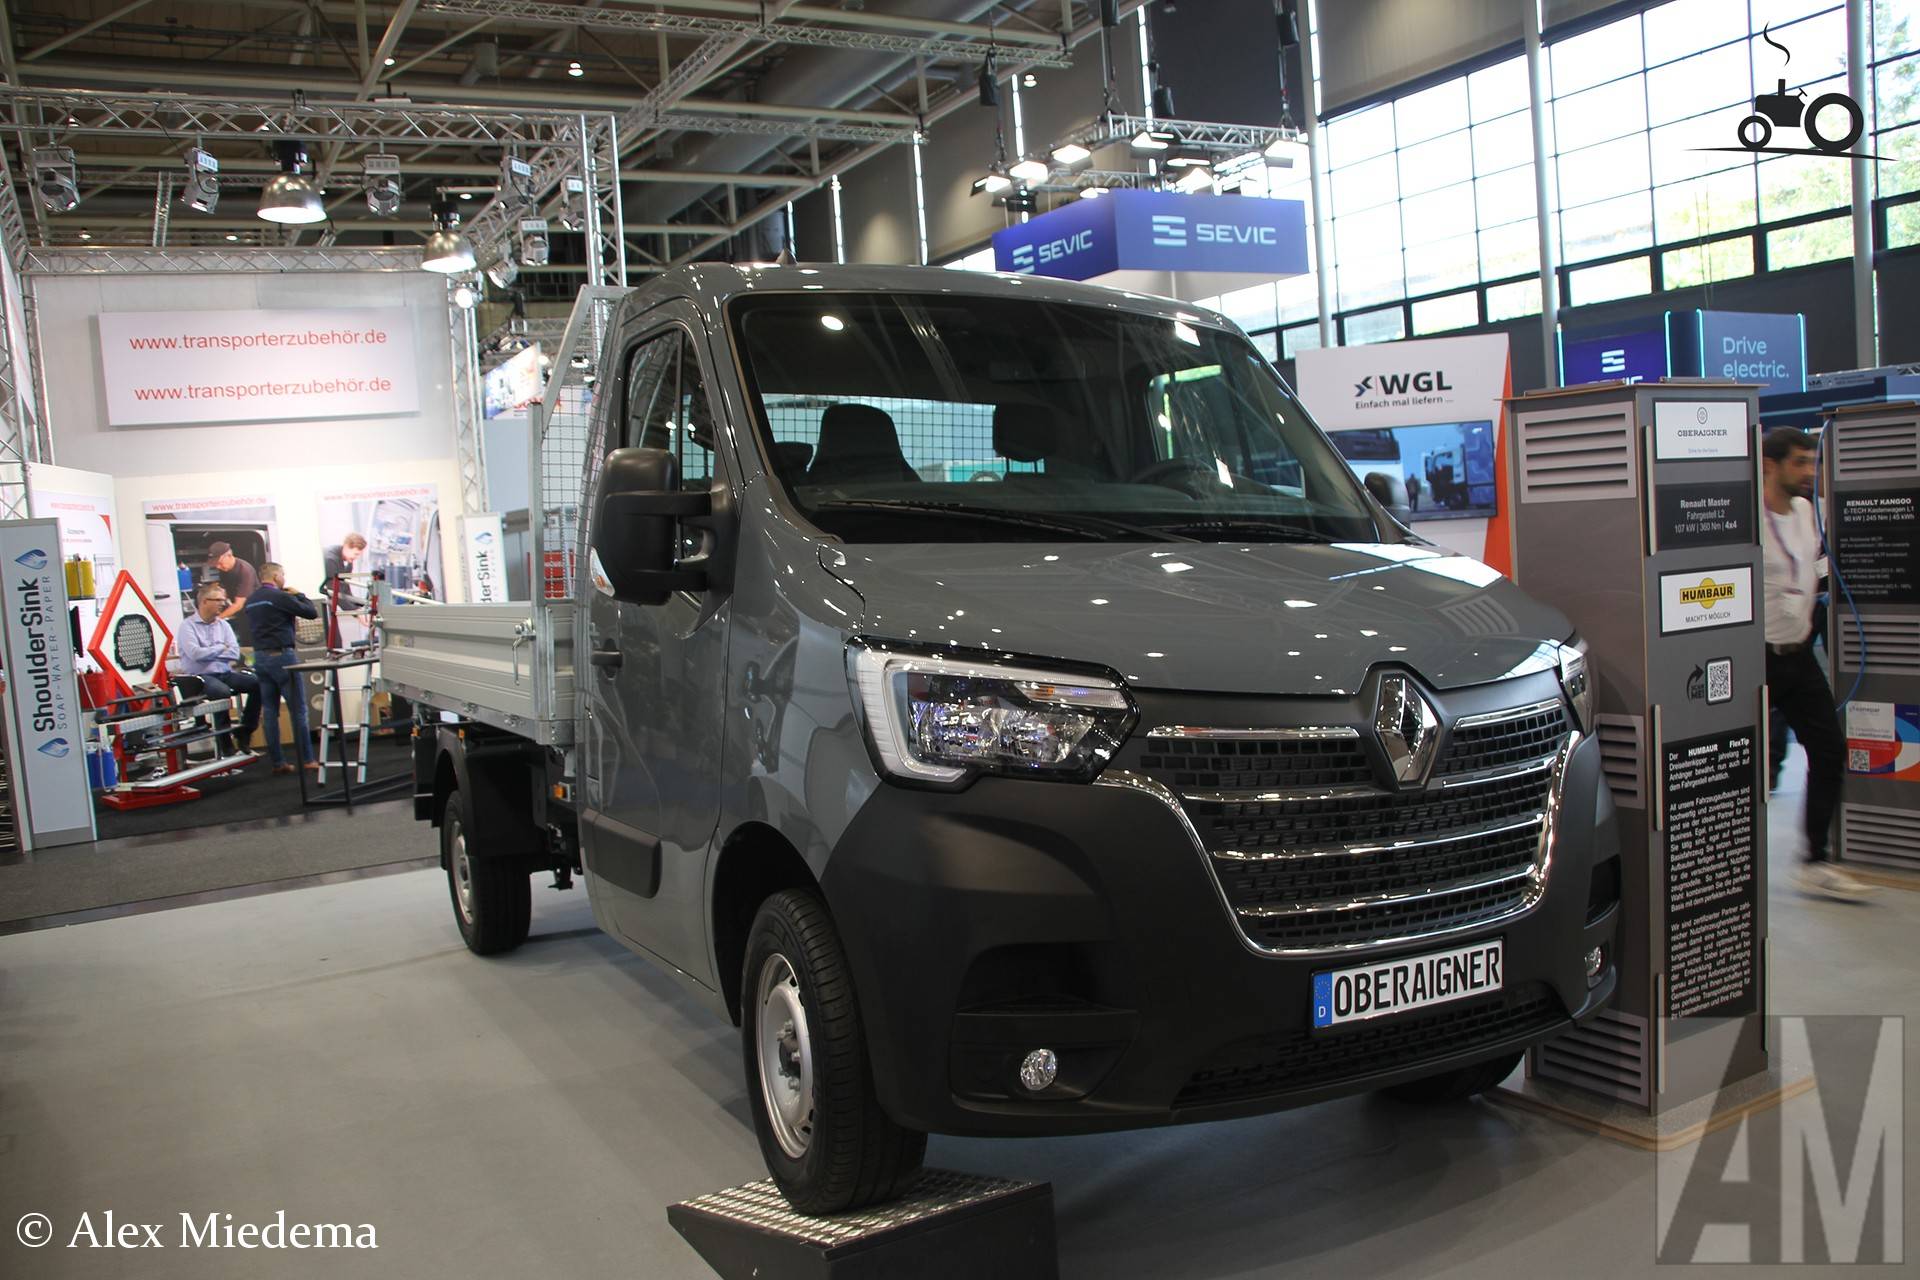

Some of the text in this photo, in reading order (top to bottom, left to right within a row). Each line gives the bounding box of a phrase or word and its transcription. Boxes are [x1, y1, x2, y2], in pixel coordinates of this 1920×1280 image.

[1196, 223, 1277, 245] SEVIC
[1038, 230, 1093, 264] SEVIC
[129, 329, 387, 350] www.transporterzubehör.de
[1723, 337, 1767, 355] Drive
[1723, 360, 1790, 379] electric.
[134, 377, 392, 400] www.transporterzubehör.de
[1379, 370, 1453, 395] WGL
[1355, 400, 1390, 410] Einfach
[1392, 398, 1410, 406] mal
[1412, 396, 1443, 405] liefern
[1677, 429, 1728, 437] OBERAIGNER
[1680, 498, 1730, 508] Renault Master
[1686, 524, 1696, 532] kW
[1712, 522, 1722, 530] Nm
[1725, 520, 1737, 530] 4x4
[1682, 586, 1733, 600] HUMBAUR
[17, 577, 56, 732] ShoulderSink
[1334, 946, 1501, 1017] OBERAIGNER
[1318, 1006, 1326, 1018] D
